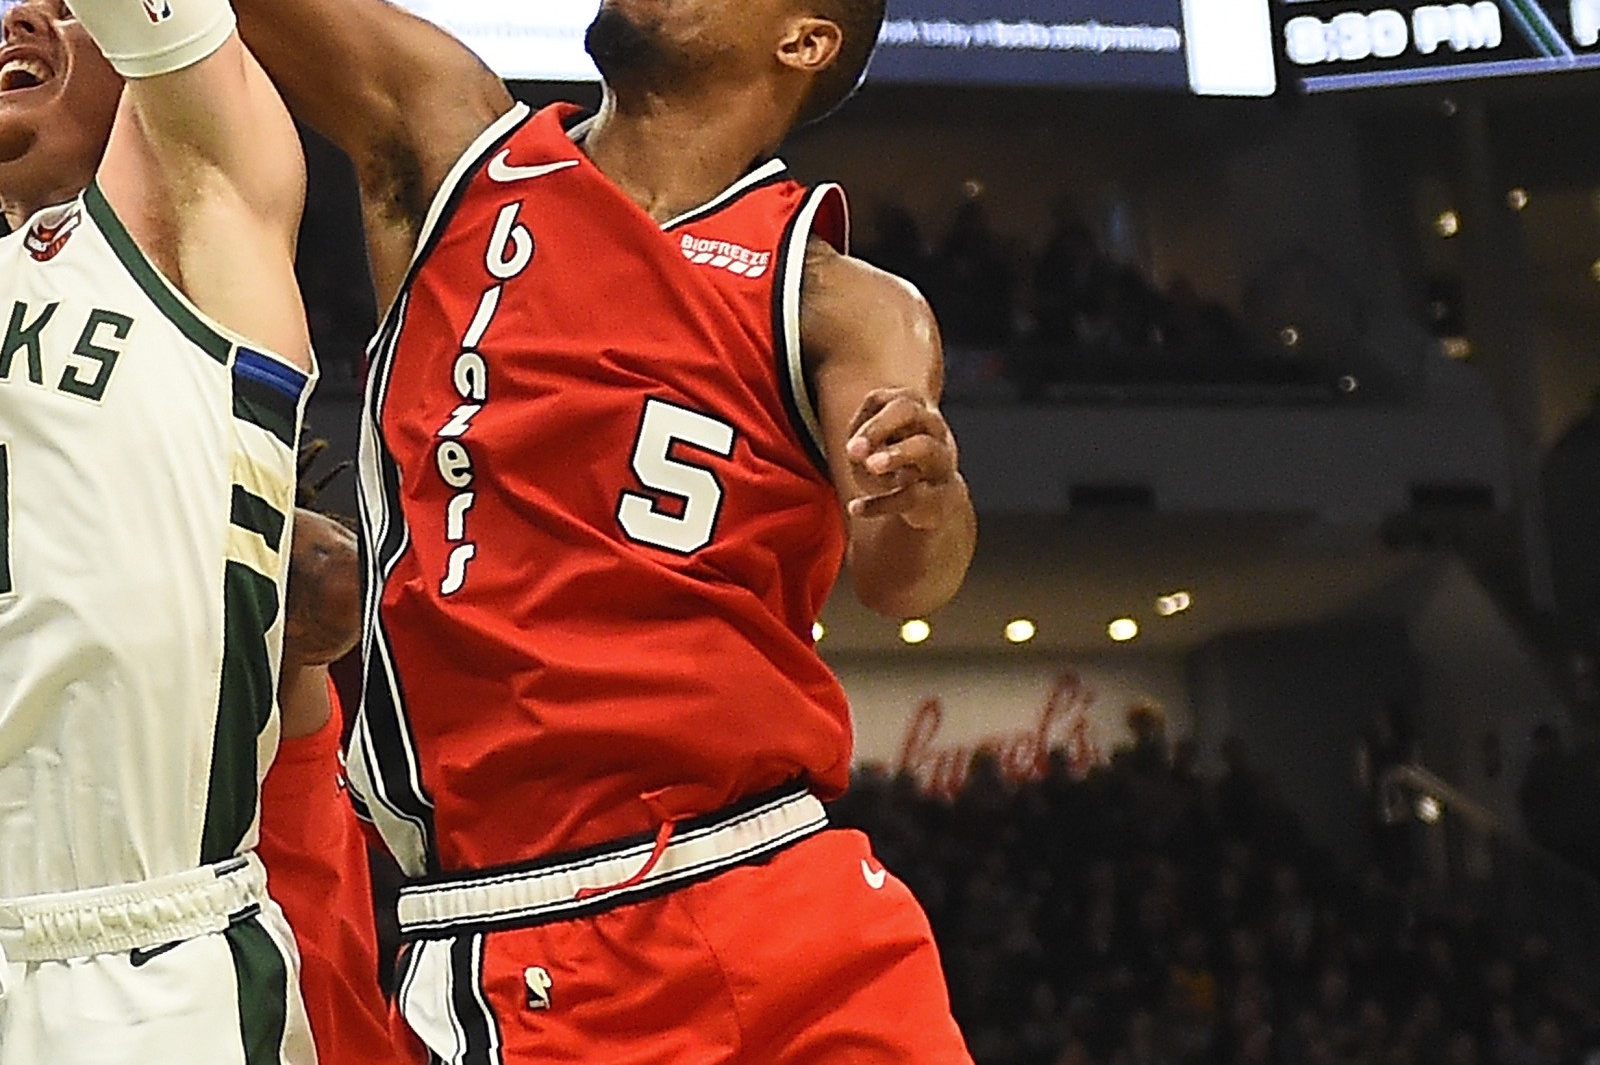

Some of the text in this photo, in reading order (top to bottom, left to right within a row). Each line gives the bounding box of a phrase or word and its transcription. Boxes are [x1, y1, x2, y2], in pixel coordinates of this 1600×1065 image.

[1412, 1, 1502, 55] PM
[680, 234, 772, 266] BIOFREEZE
[434, 199, 534, 597] blazers
[616, 398, 734, 555] 5
